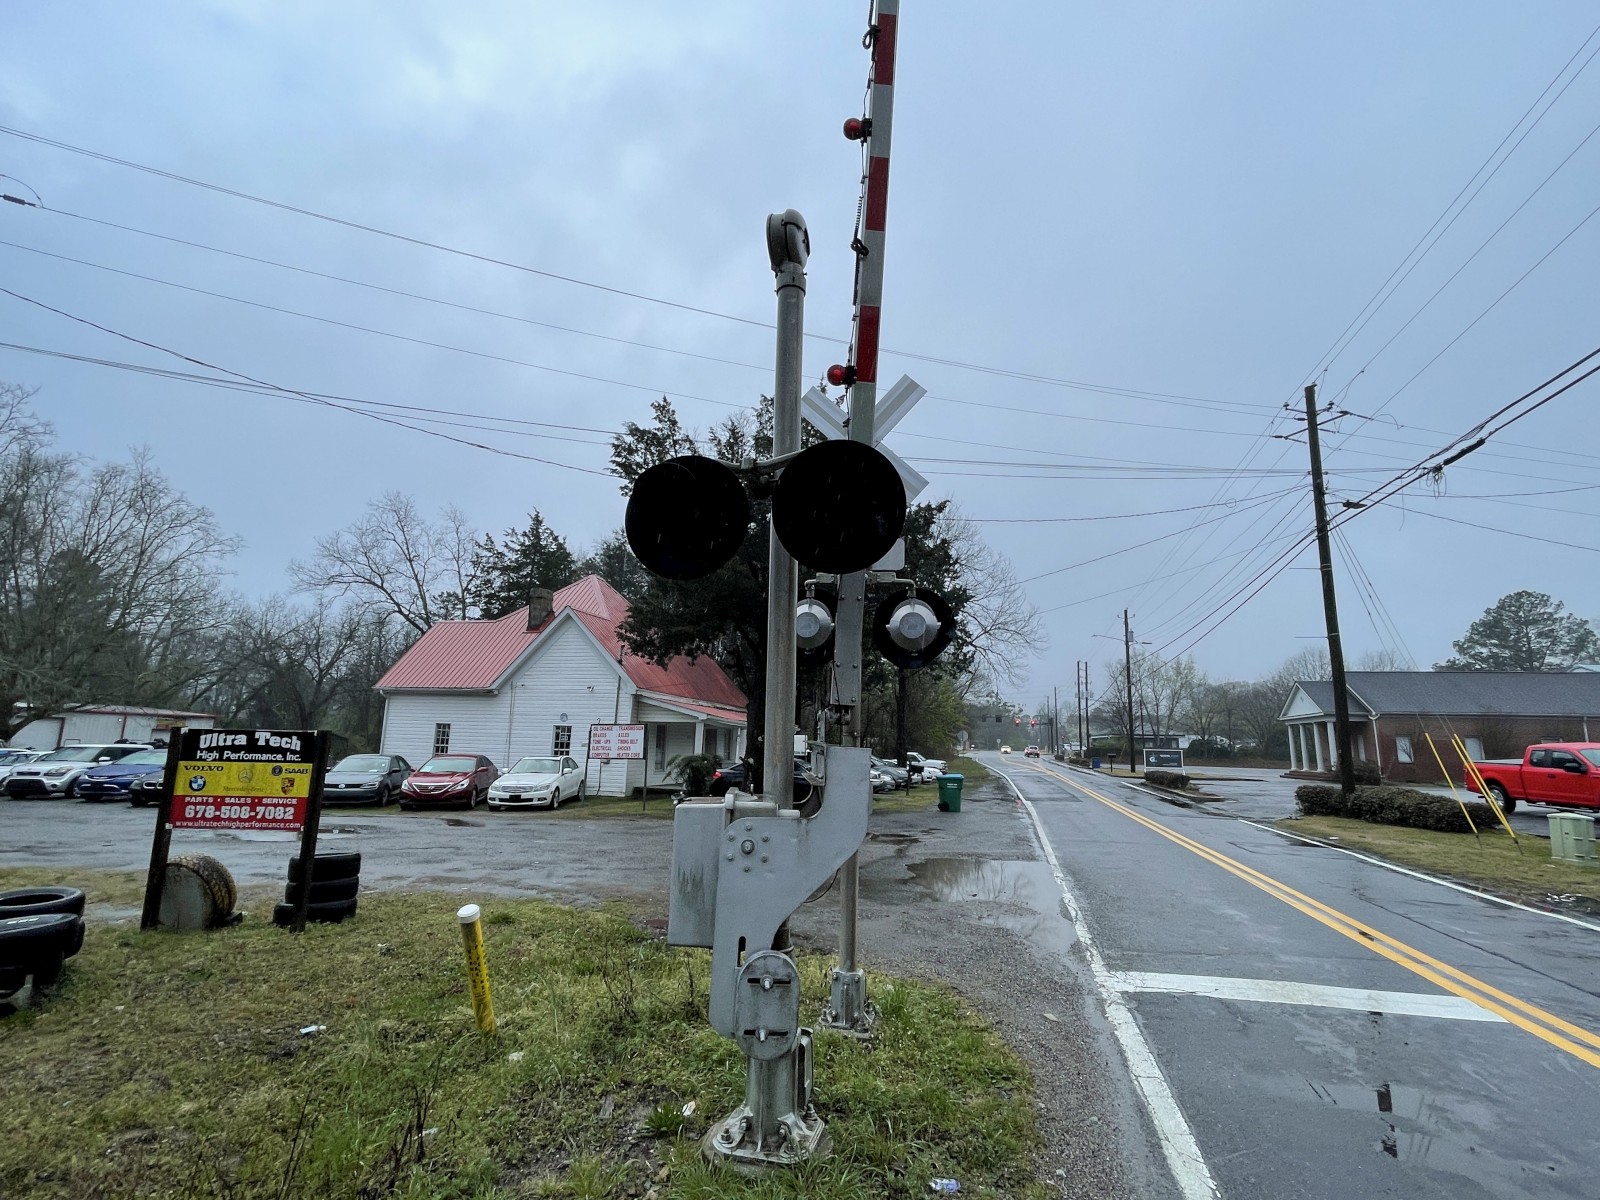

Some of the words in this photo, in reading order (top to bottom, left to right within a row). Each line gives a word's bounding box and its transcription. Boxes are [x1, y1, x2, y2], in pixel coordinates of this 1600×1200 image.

[200, 733, 247, 749] Ultra
[255, 732, 300, 750] Tech
[196, 750, 218, 761] High
[286, 752, 301, 761] Inc.
[185, 806, 294, 820] 678-508-7082
[176, 820, 300, 829] www.ultratechhighperformance.com
